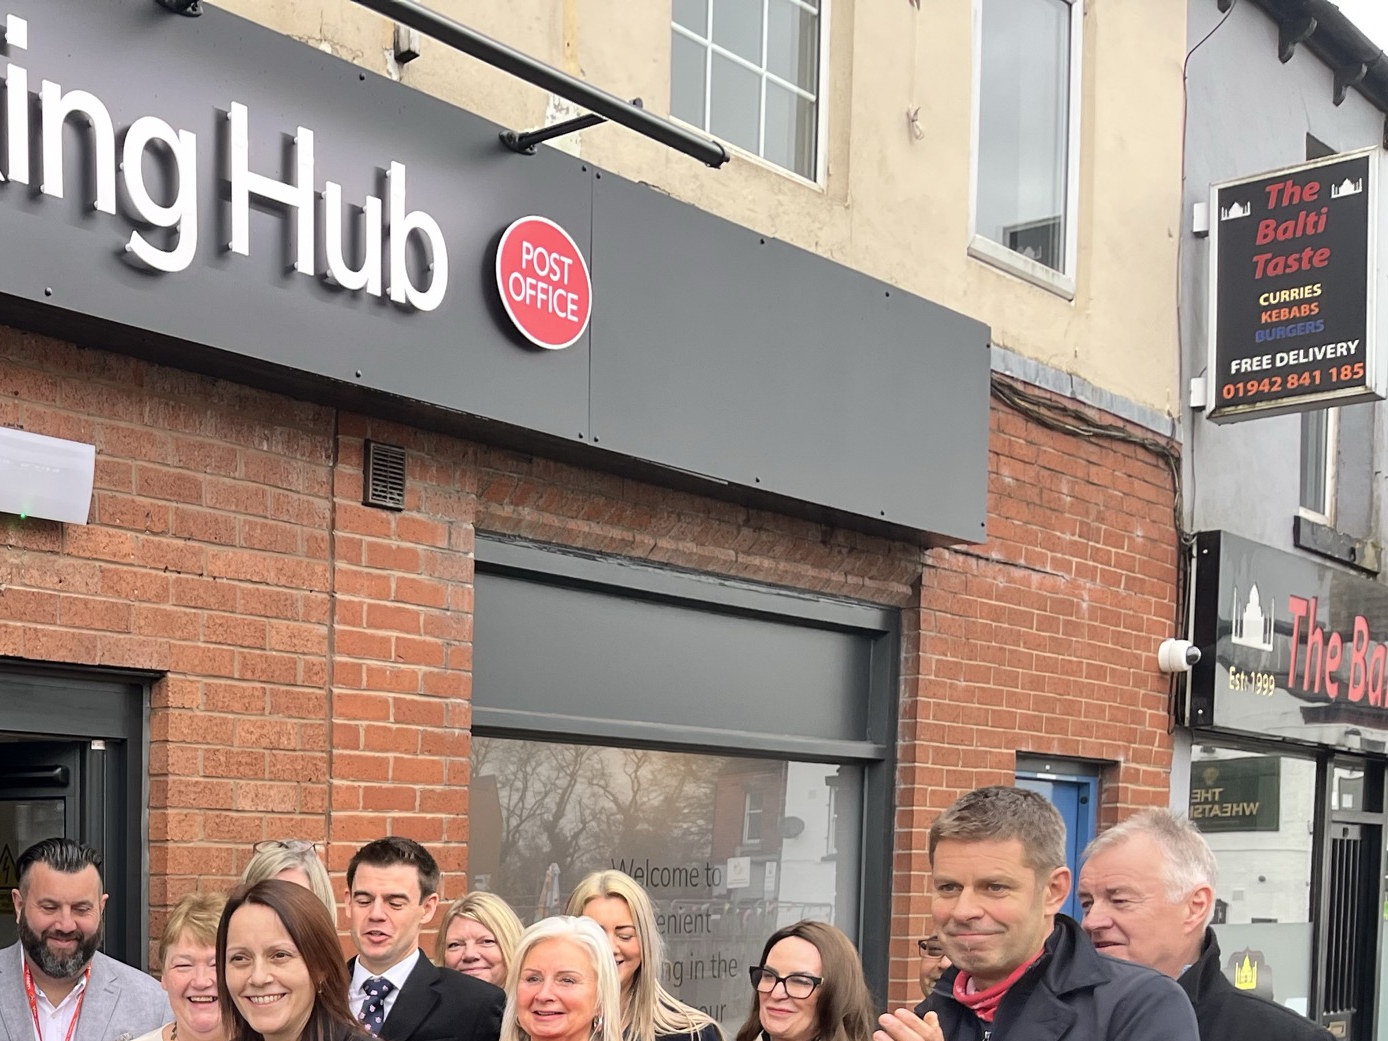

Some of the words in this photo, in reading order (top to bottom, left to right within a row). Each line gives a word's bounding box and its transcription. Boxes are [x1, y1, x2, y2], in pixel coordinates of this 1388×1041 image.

[231, 100, 449, 311] Hub
[1265, 180, 1321, 210] The
[1255, 206, 1329, 246] Balti
[522, 240, 573, 285] POST
[1252, 246, 1330, 280] Taste
[508, 271, 579, 322] OFFICE
[1259, 283, 1322, 306] CURRIES
[1261, 302, 1320, 324] KEBABS
[1255, 319, 1325, 343] BURGERS
[1231, 354, 1272, 375] FREE
[1275, 339, 1360, 368] DELIVERY
[1222, 375, 1283, 400] 01942
[1287, 369, 1321, 391] 841
[1329, 362, 1365, 383] 185
[1287, 594, 1344, 699] The
[1348, 614, 1388, 708] Ba
[1250, 671, 1276, 696] 1999
[611, 858, 699, 888] Welcome
[704, 862, 722, 888] to
[656, 906, 712, 934] enient
[689, 953, 705, 980] in
[710, 951, 738, 979] the
[697, 1002, 727, 1024] our
